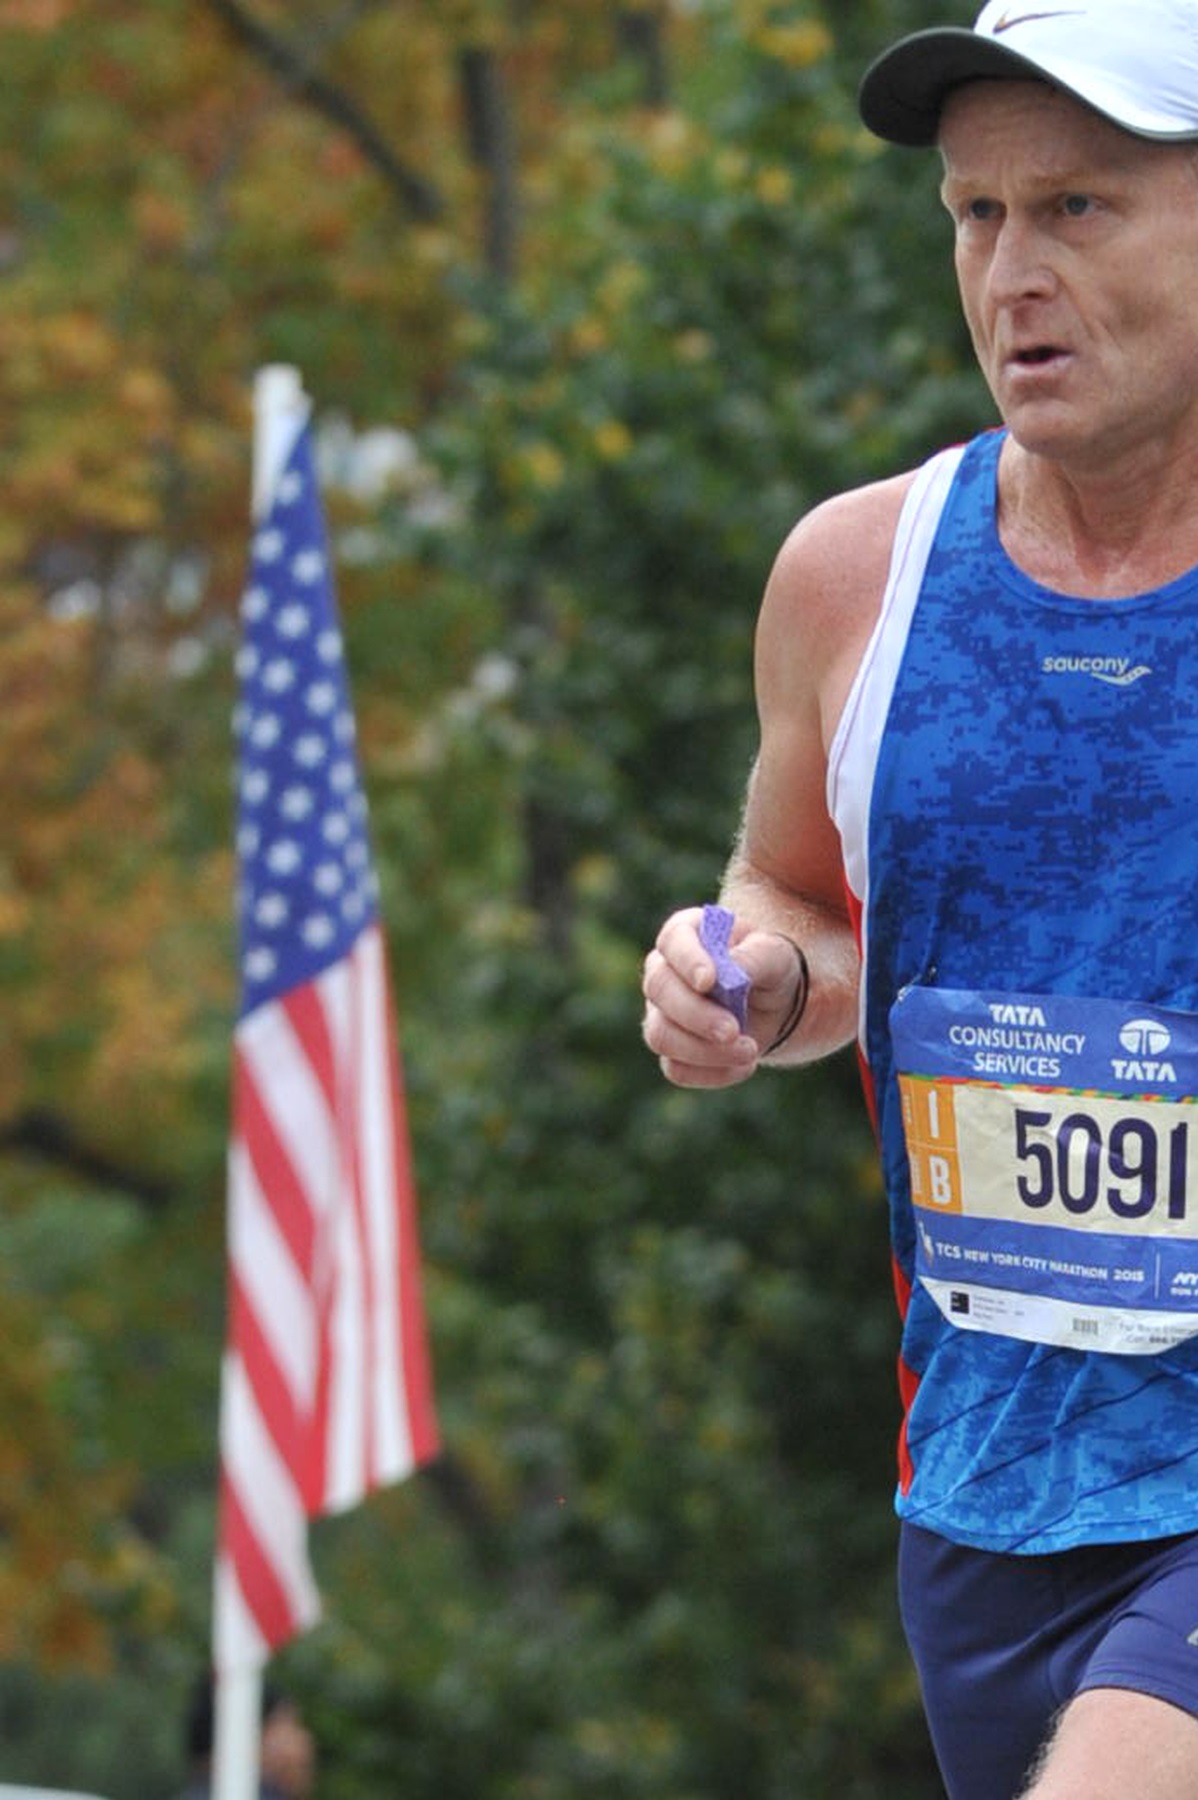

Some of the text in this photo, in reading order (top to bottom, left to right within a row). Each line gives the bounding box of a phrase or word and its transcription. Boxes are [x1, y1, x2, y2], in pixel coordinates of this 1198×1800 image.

[1042, 656, 1129, 675] saucony
[989, 1004, 1046, 1027] TATA
[949, 1025, 1086, 1055] CONSULTANCY
[973, 1052, 1061, 1078] SERVICES
[1111, 1060, 1177, 1082] TATA
[1015, 1108, 1188, 1219] 5091
[929, 1155, 952, 1205] B
[936, 1242, 961, 1260] TCS
[963, 1248, 990, 1263] NEW
[991, 1252, 1021, 1267] YORK
[1021, 1256, 1047, 1271] CITY
[1049, 1260, 1108, 1280] MARATHON
